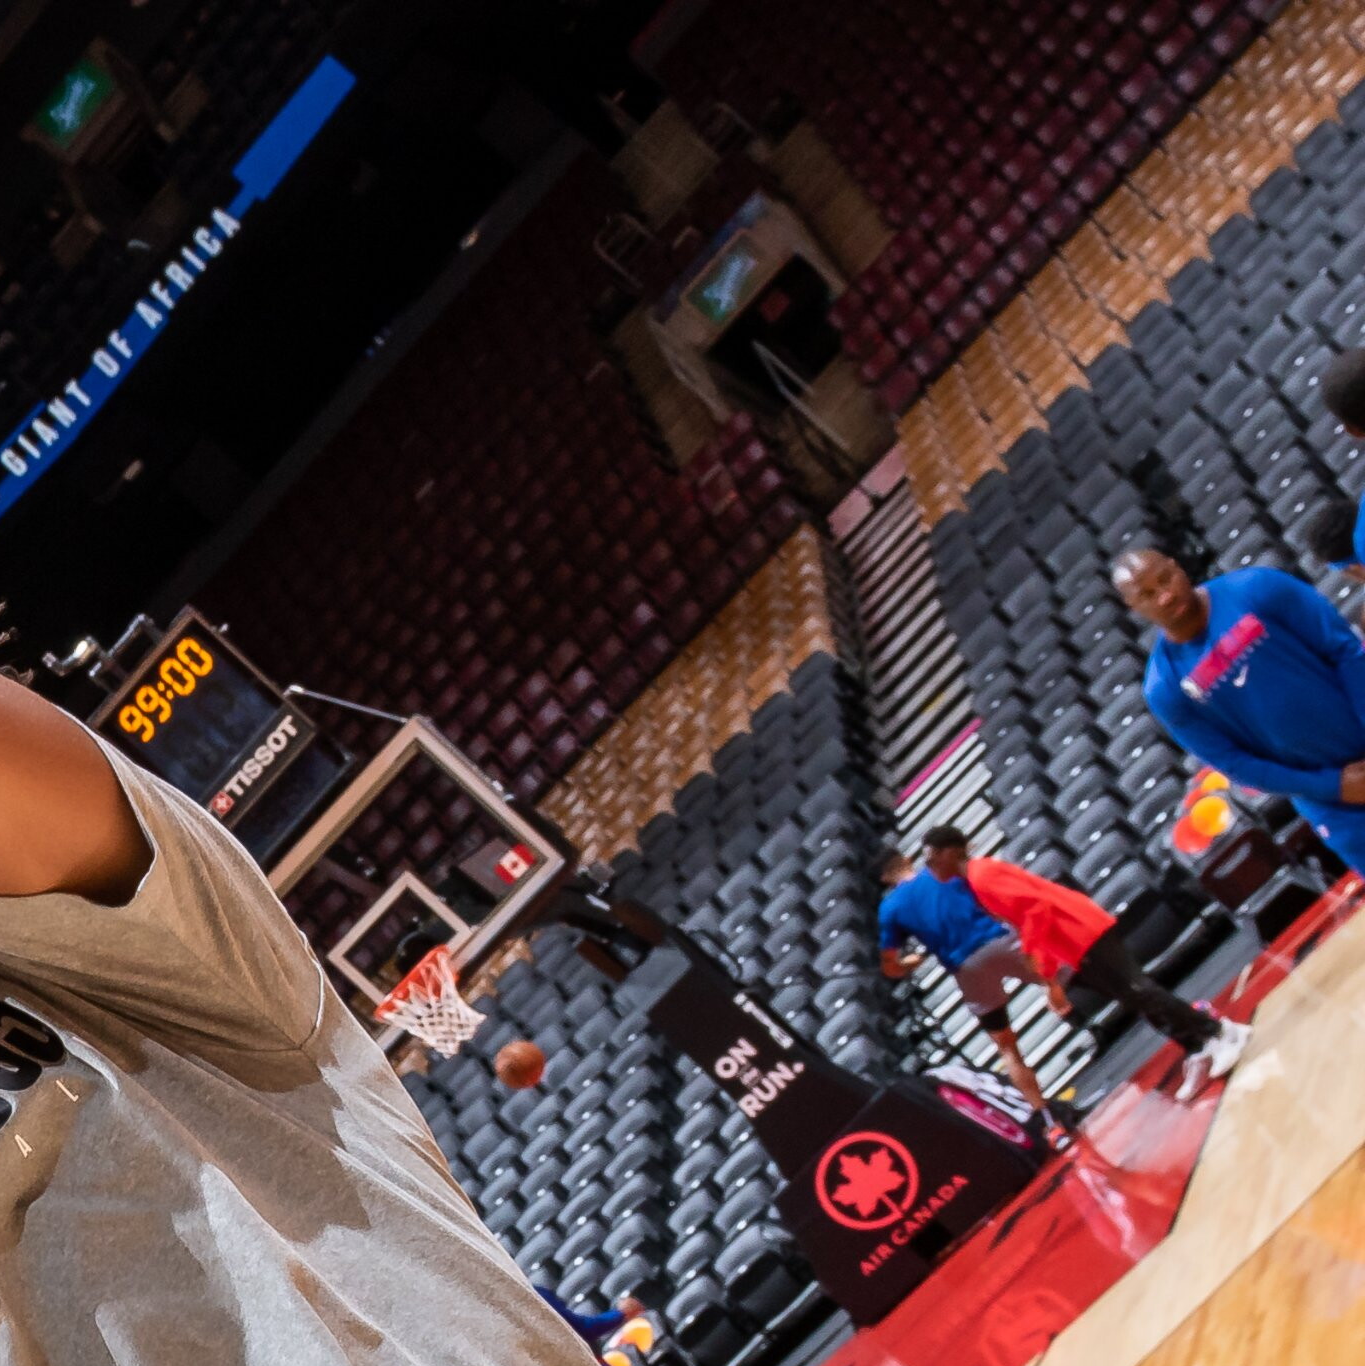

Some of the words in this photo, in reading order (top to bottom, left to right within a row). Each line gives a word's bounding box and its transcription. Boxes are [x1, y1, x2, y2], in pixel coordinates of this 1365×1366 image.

[0, 377, 92, 477] GIANT
[91, 329, 134, 379] OF
[134, 206, 242, 330] AFRICA
[118, 636, 215, 743] 99:00
[223, 714, 299, 797] TISSOT
[714, 1036, 758, 1079] ON
[737, 1061, 806, 1118] RUN.
[859, 1243, 895, 1277] AIR
[891, 1174, 970, 1246] CANADA
